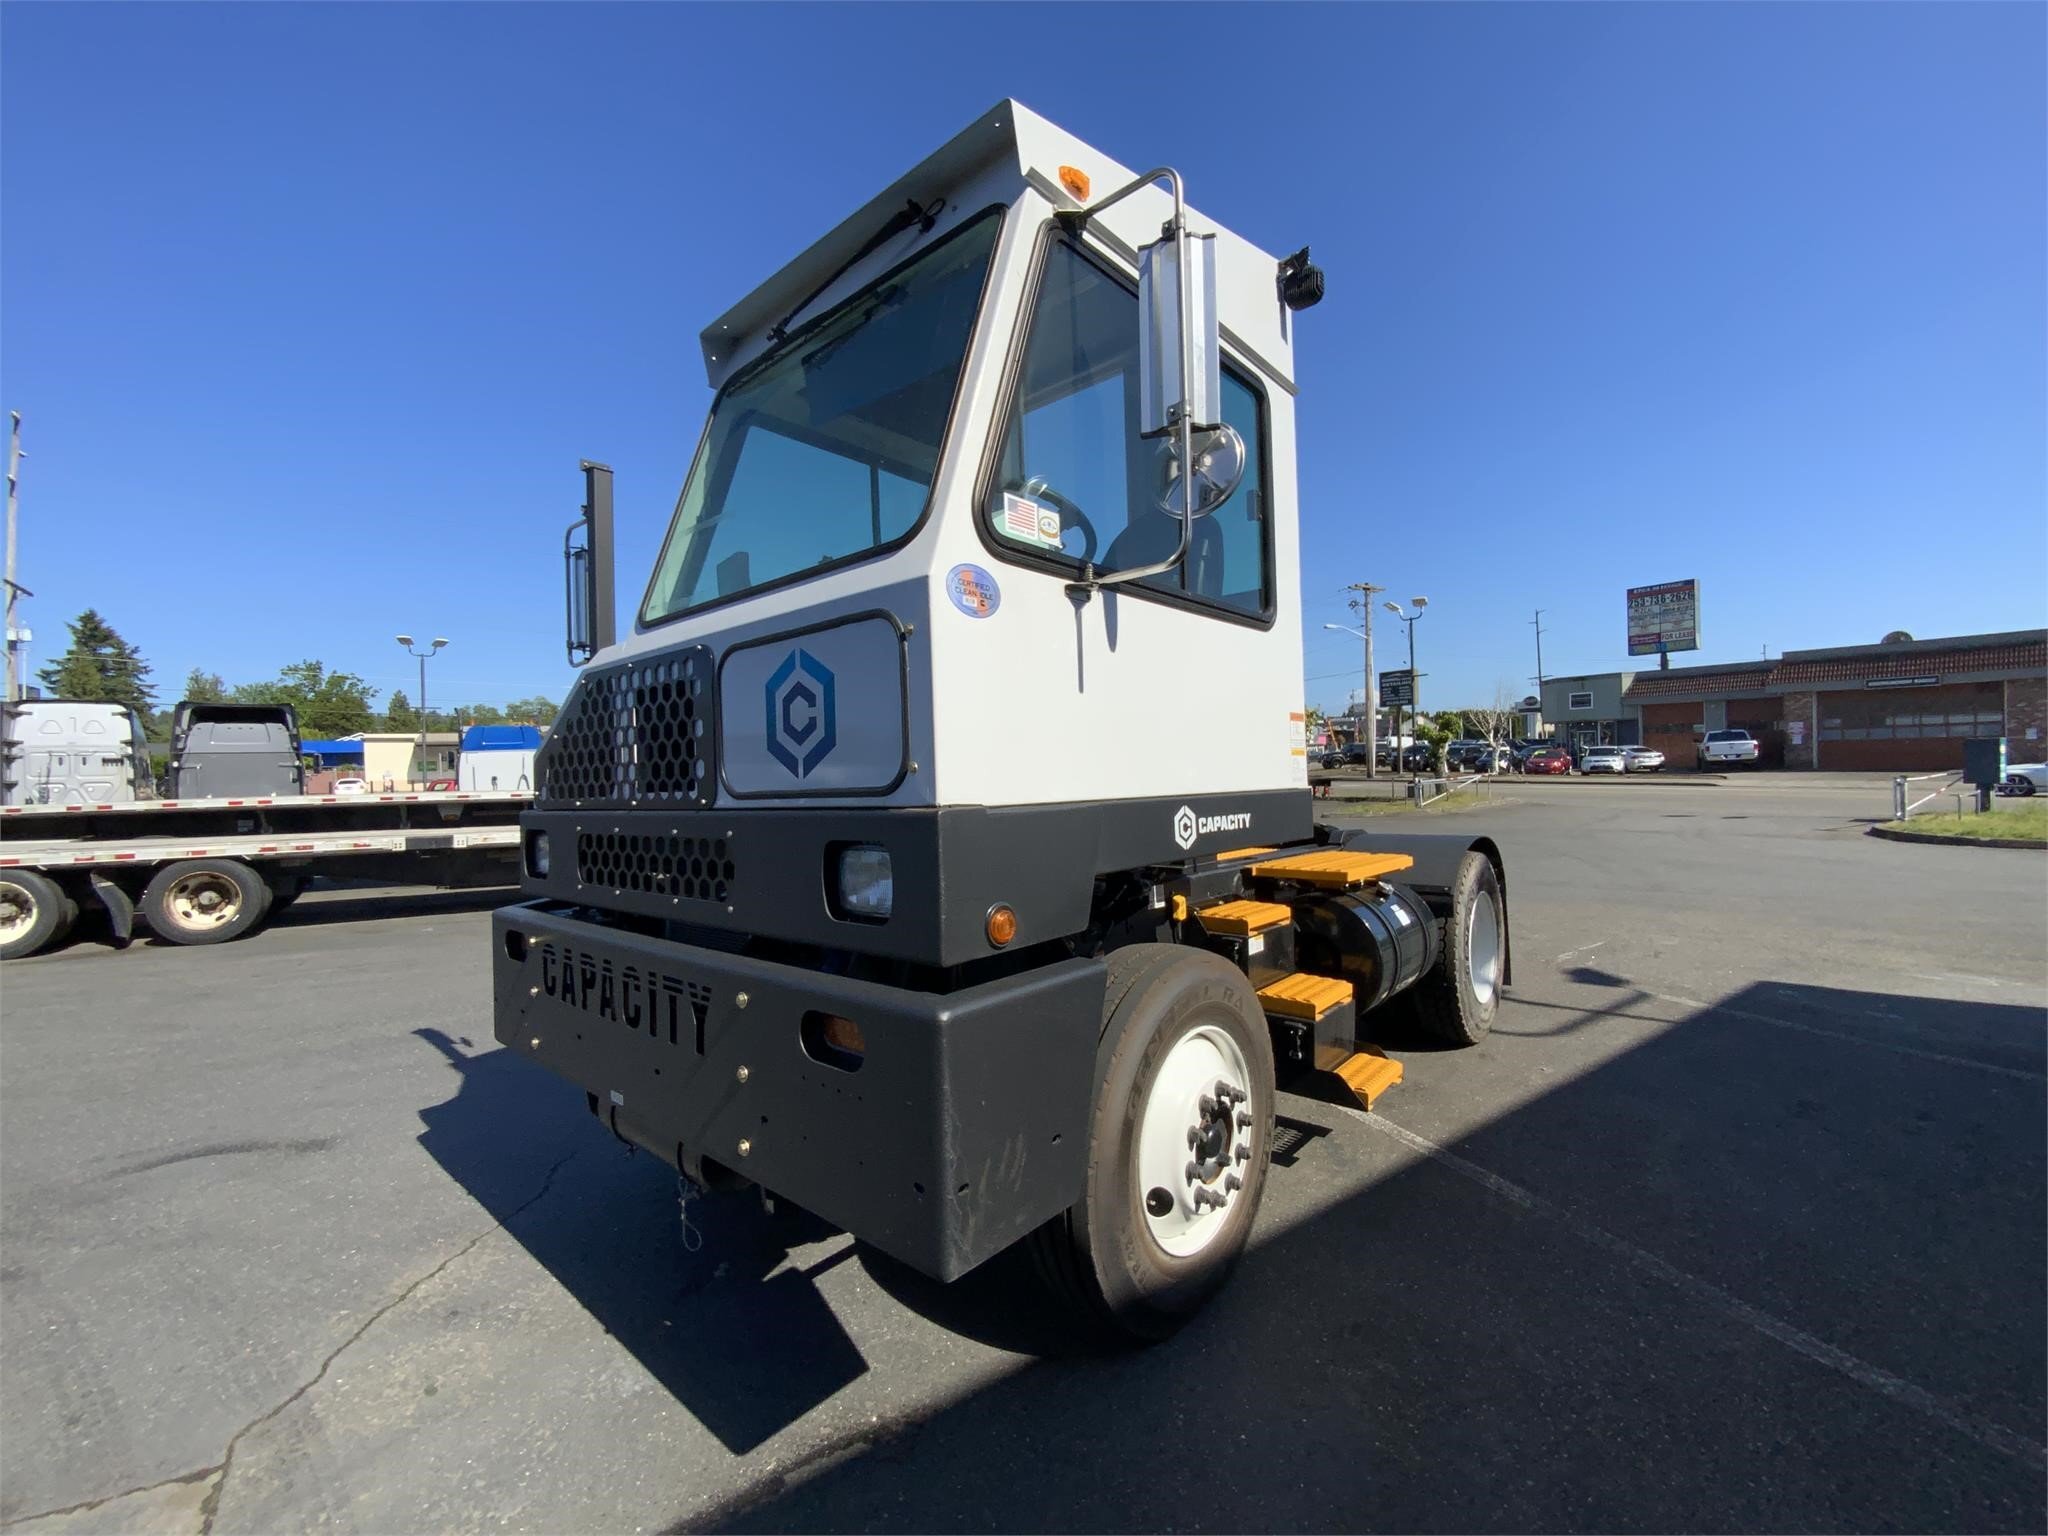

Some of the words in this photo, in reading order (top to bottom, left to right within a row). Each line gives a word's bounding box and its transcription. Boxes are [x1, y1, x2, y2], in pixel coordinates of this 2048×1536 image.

[954, 586, 977, 598] CLEAN
[957, 578, 991, 592] CERTIFIED
[1661, 632, 1674, 641] FOR
[1675, 630, 1695, 639] LEASE
[1198, 812, 1251, 834] CAPACITY
[542, 943, 713, 1056] CAPACITY
